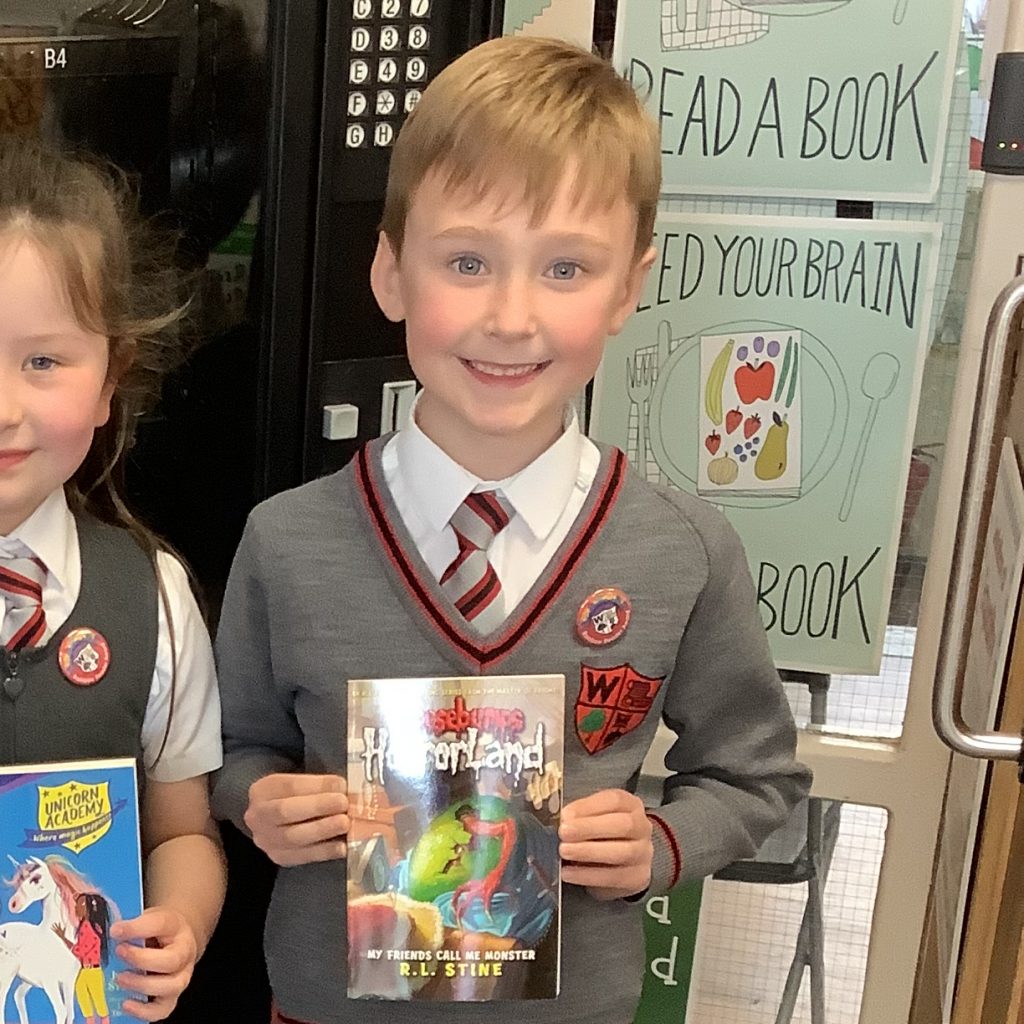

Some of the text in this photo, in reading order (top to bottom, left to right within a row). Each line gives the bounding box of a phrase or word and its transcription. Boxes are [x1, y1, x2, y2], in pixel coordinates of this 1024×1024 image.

[356, 29, 422, 48] D 3 8
[45, 47, 68, 69] B4
[355, 60, 420, 80] E 4 9
[353, 95, 361, 112] F
[747, 77, 784, 159] A
[800, 50, 939, 164] BOOK
[350, 126, 388, 144] G H
[714, 235, 798, 297] YOUR
[803, 238, 922, 328] BRAIN
[757, 547, 881, 644] BOOK
[586, 671, 621, 704] W
[361, 722, 544, 788] HorLand
[44, 797, 104, 829] ACADEMY
[45, 785, 99, 815] UNICORN
[367, 949, 536, 961] MY FRIENDS CALL ME MONSTER
[399, 962, 503, 978] R.L. STINE
